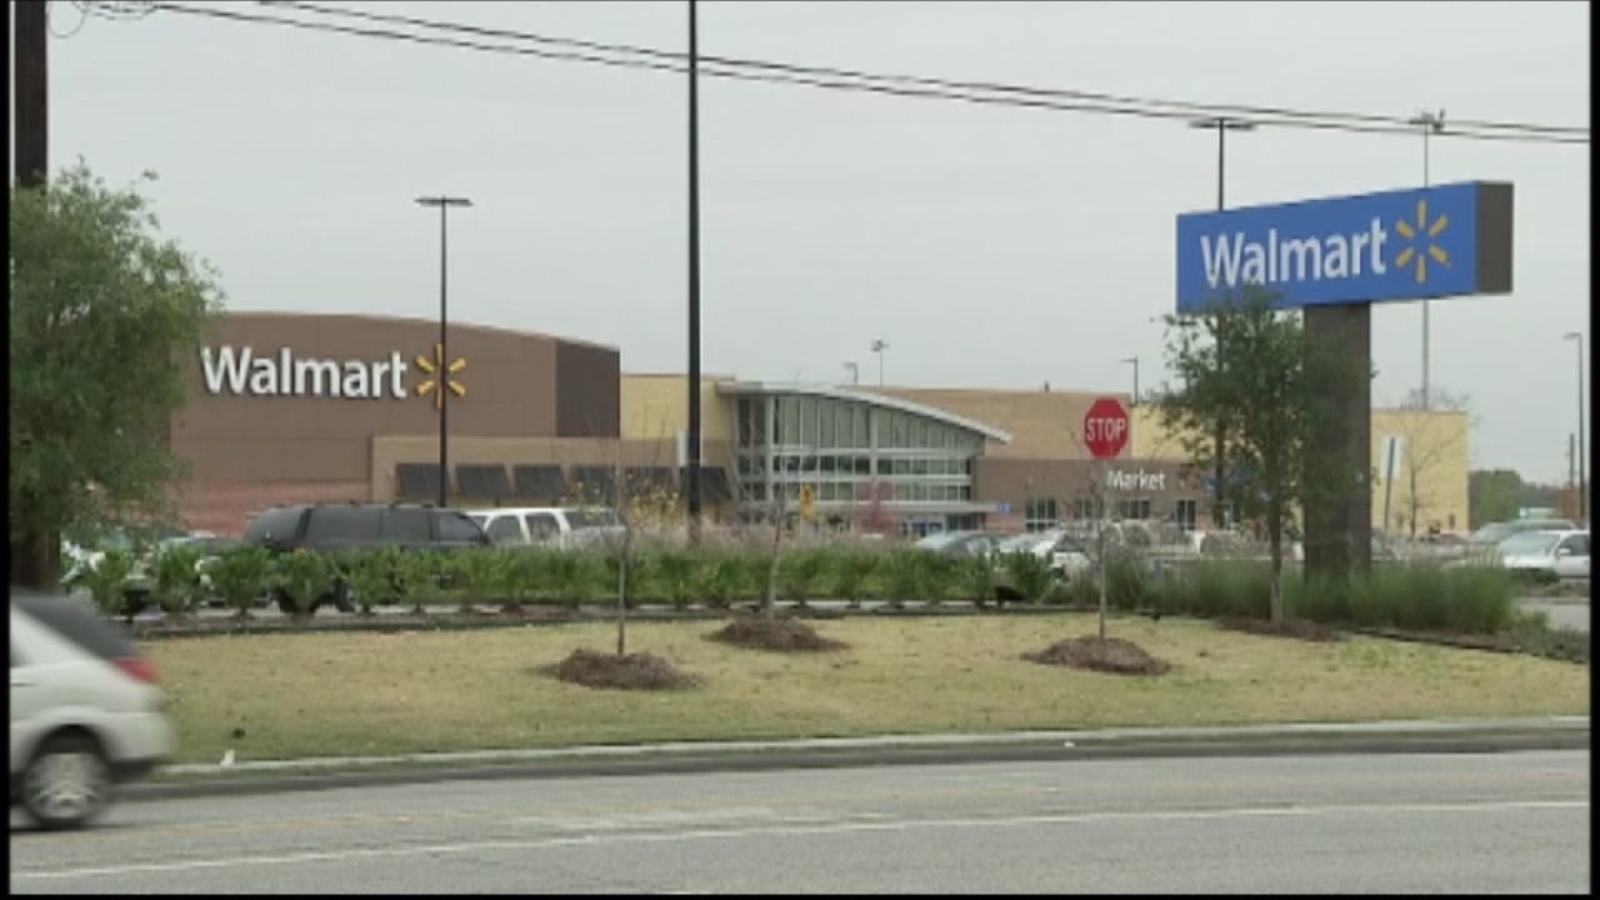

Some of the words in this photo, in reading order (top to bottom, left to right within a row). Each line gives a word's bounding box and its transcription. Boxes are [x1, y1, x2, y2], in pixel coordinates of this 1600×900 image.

[1201, 217, 1387, 289] Walmart
[201, 345, 407, 397] Walmart
[1086, 417, 1126, 442] STOP
[1106, 468, 1165, 490] Market
